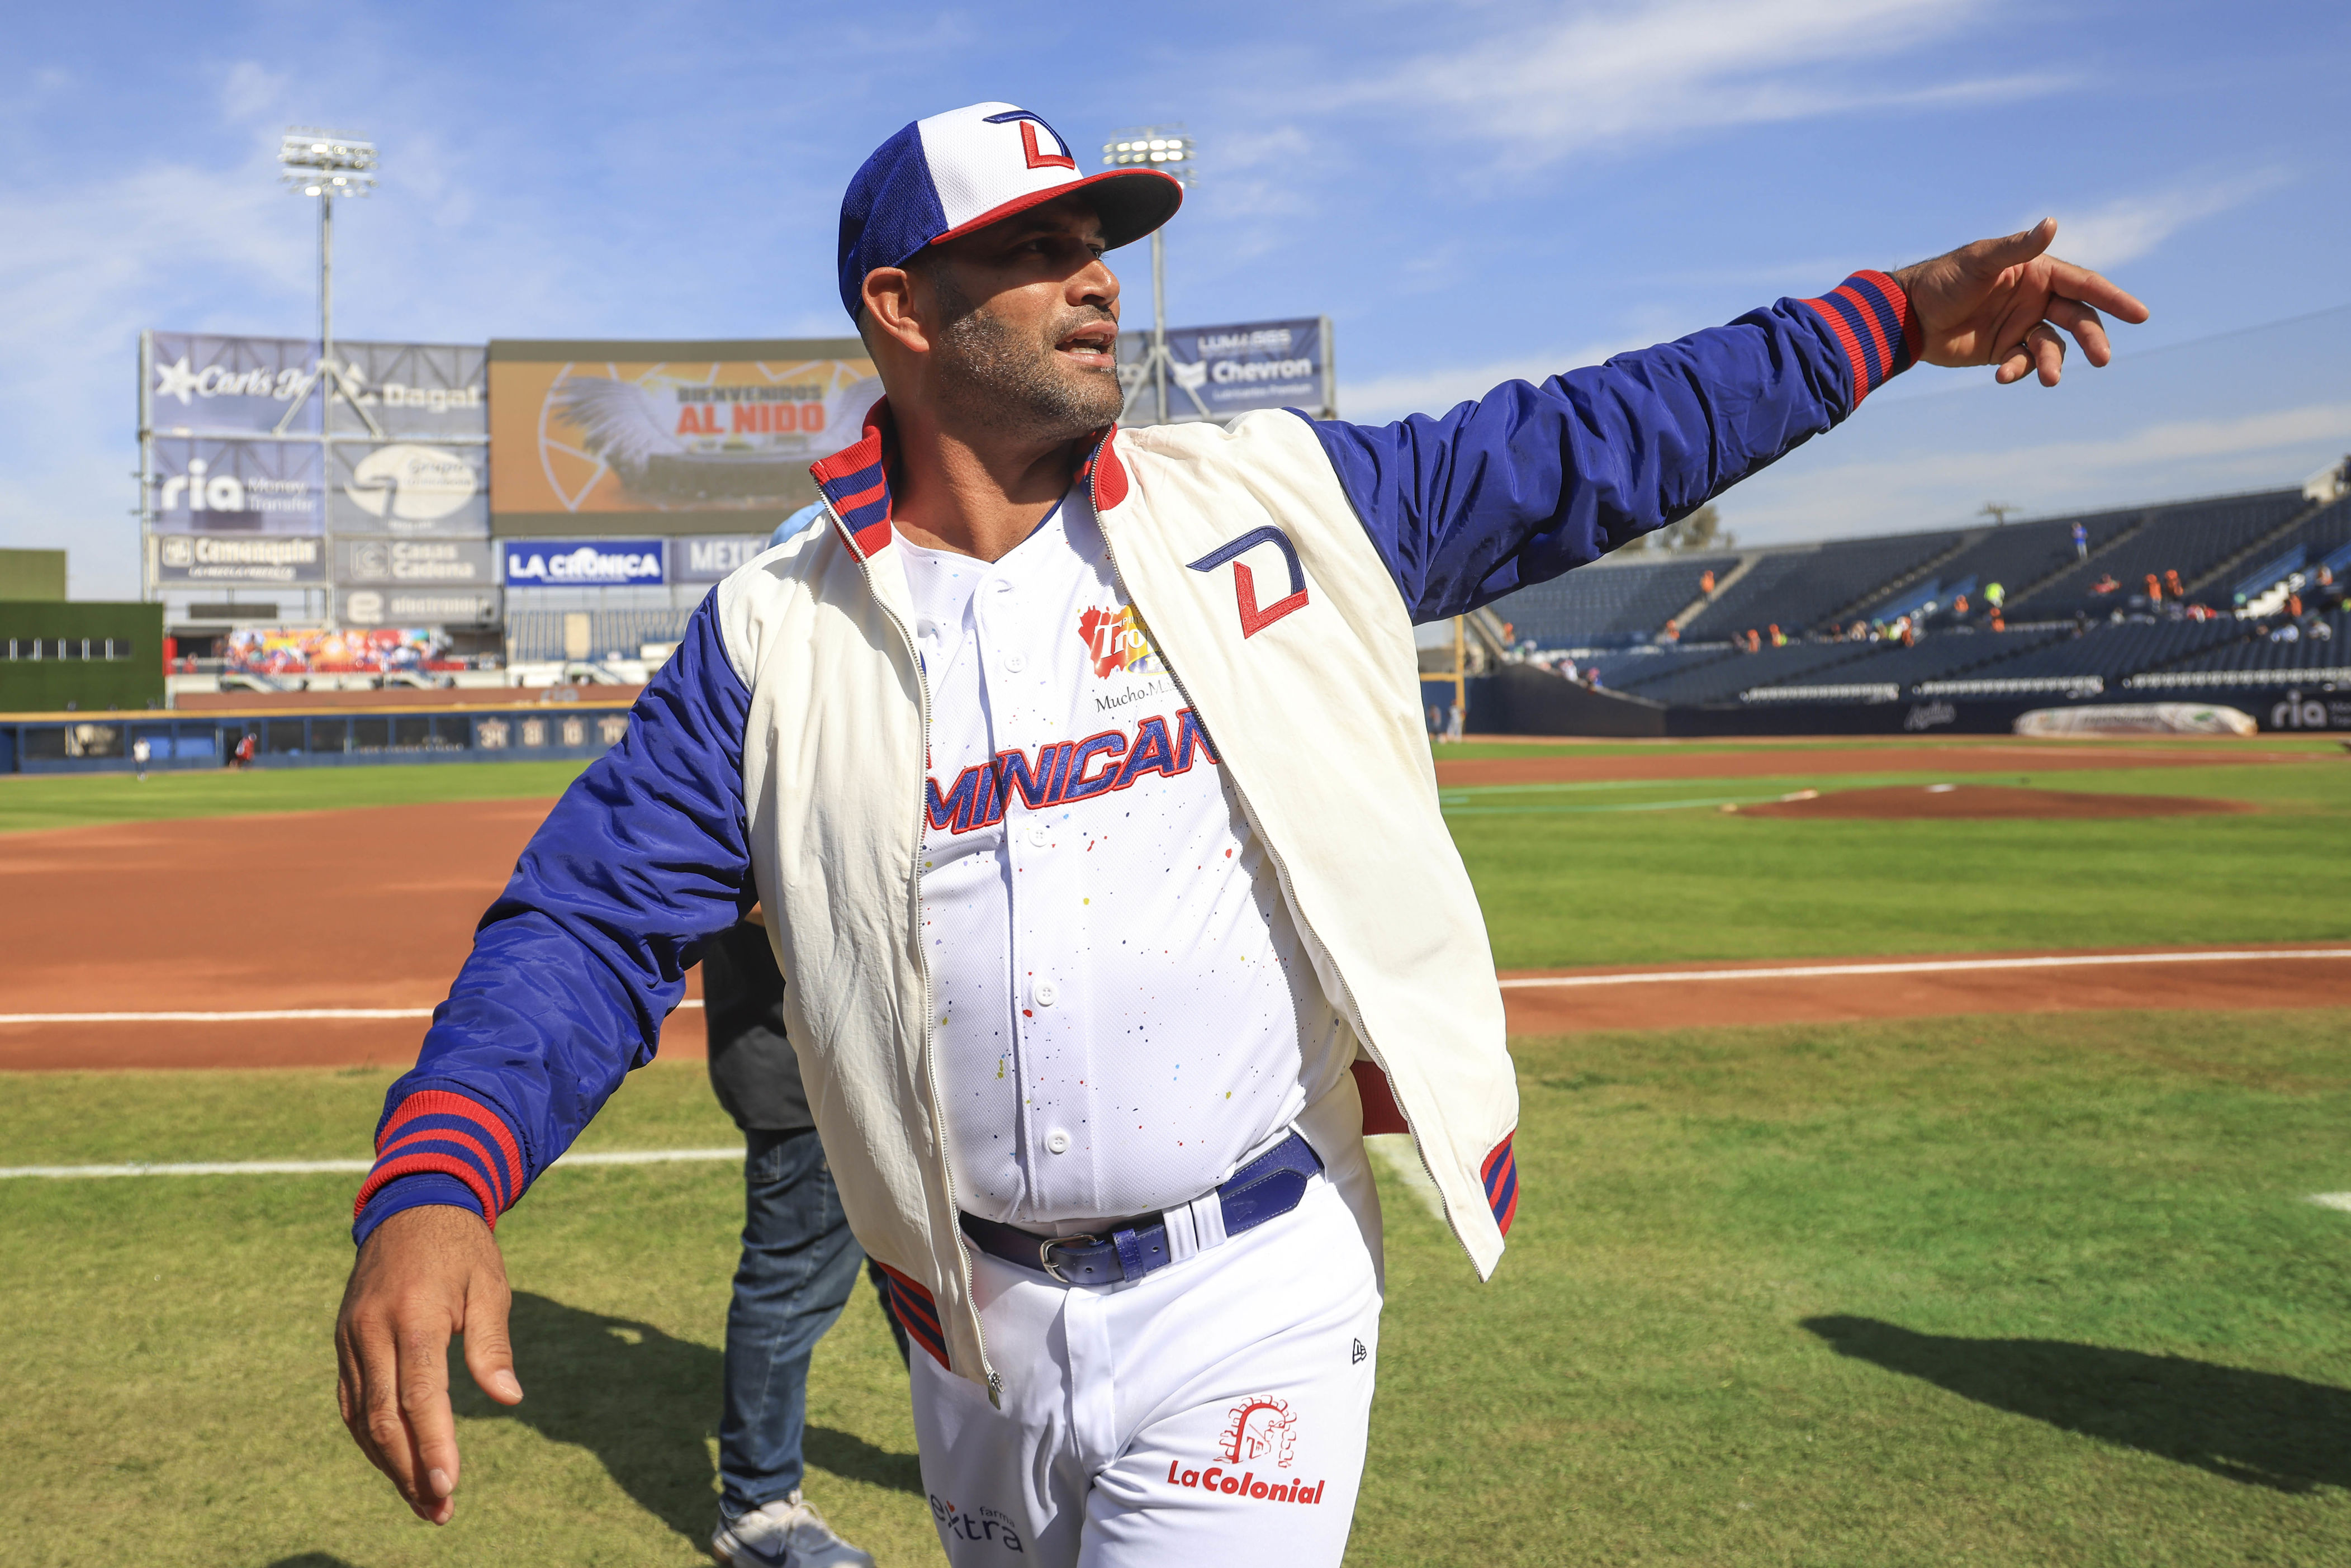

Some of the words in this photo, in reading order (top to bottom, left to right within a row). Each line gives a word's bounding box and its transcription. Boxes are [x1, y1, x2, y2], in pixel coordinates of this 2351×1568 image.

[196, 364, 273, 399] Carl's
[1212, 358, 1312, 384] Chevron
[678, 385, 822, 403] BIENVENIDOS
[676, 404, 725, 435] AL
[732, 401, 826, 434] NIDO
[161, 458, 245, 513] ria
[248, 477, 306, 496] Money
[249, 495, 313, 511] Transfer
[509, 554, 546, 578] LA
[1094, 620, 1156, 659] Tro
[1095, 686, 1145, 713] Mucho
[2271, 689, 2328, 728] ria
[980, 1506, 1015, 1528] farma
